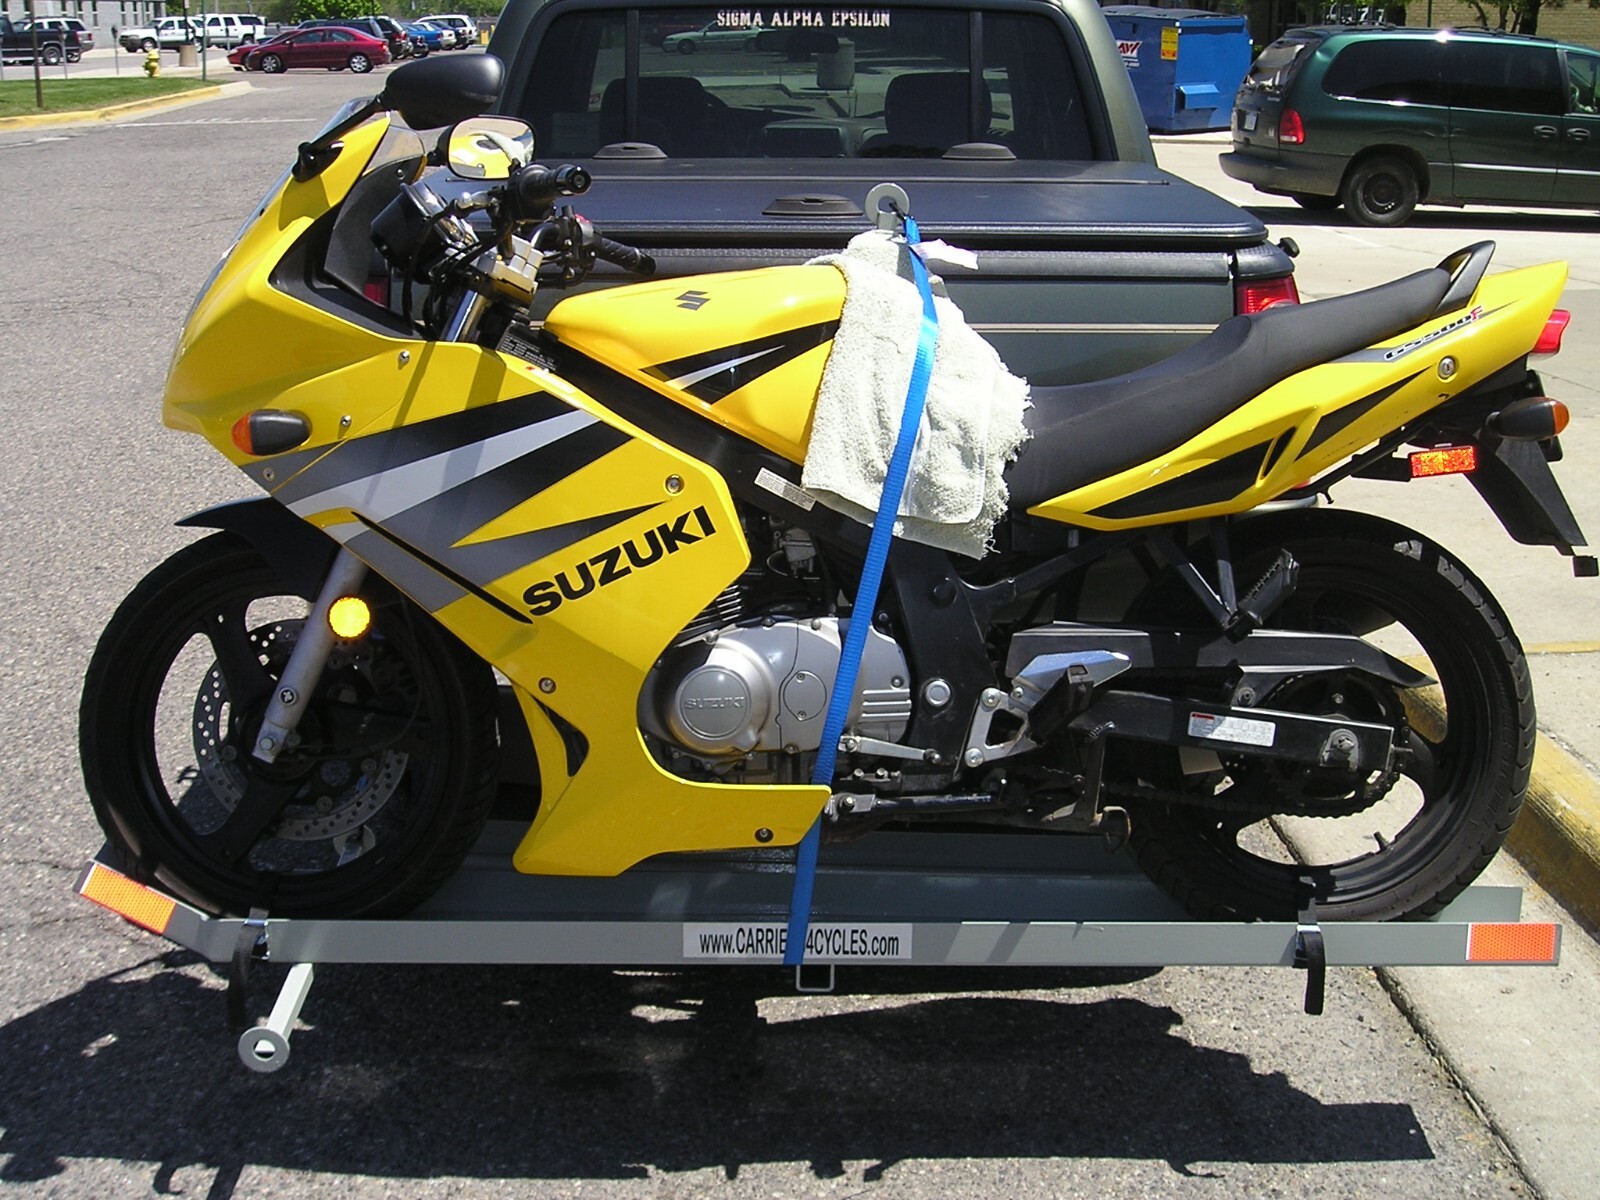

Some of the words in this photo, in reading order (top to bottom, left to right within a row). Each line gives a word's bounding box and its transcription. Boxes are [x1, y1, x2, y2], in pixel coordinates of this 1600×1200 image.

[717, 11, 764, 27] SIGMA
[771, 11, 824, 27] ALPHA
[831, 11, 890, 27] EPSILON
[522, 505, 717, 617] SUZUKI
[683, 696, 745, 710] SUZUKI
[699, 927, 900, 956] www.CARRIE4CYCLES.com
